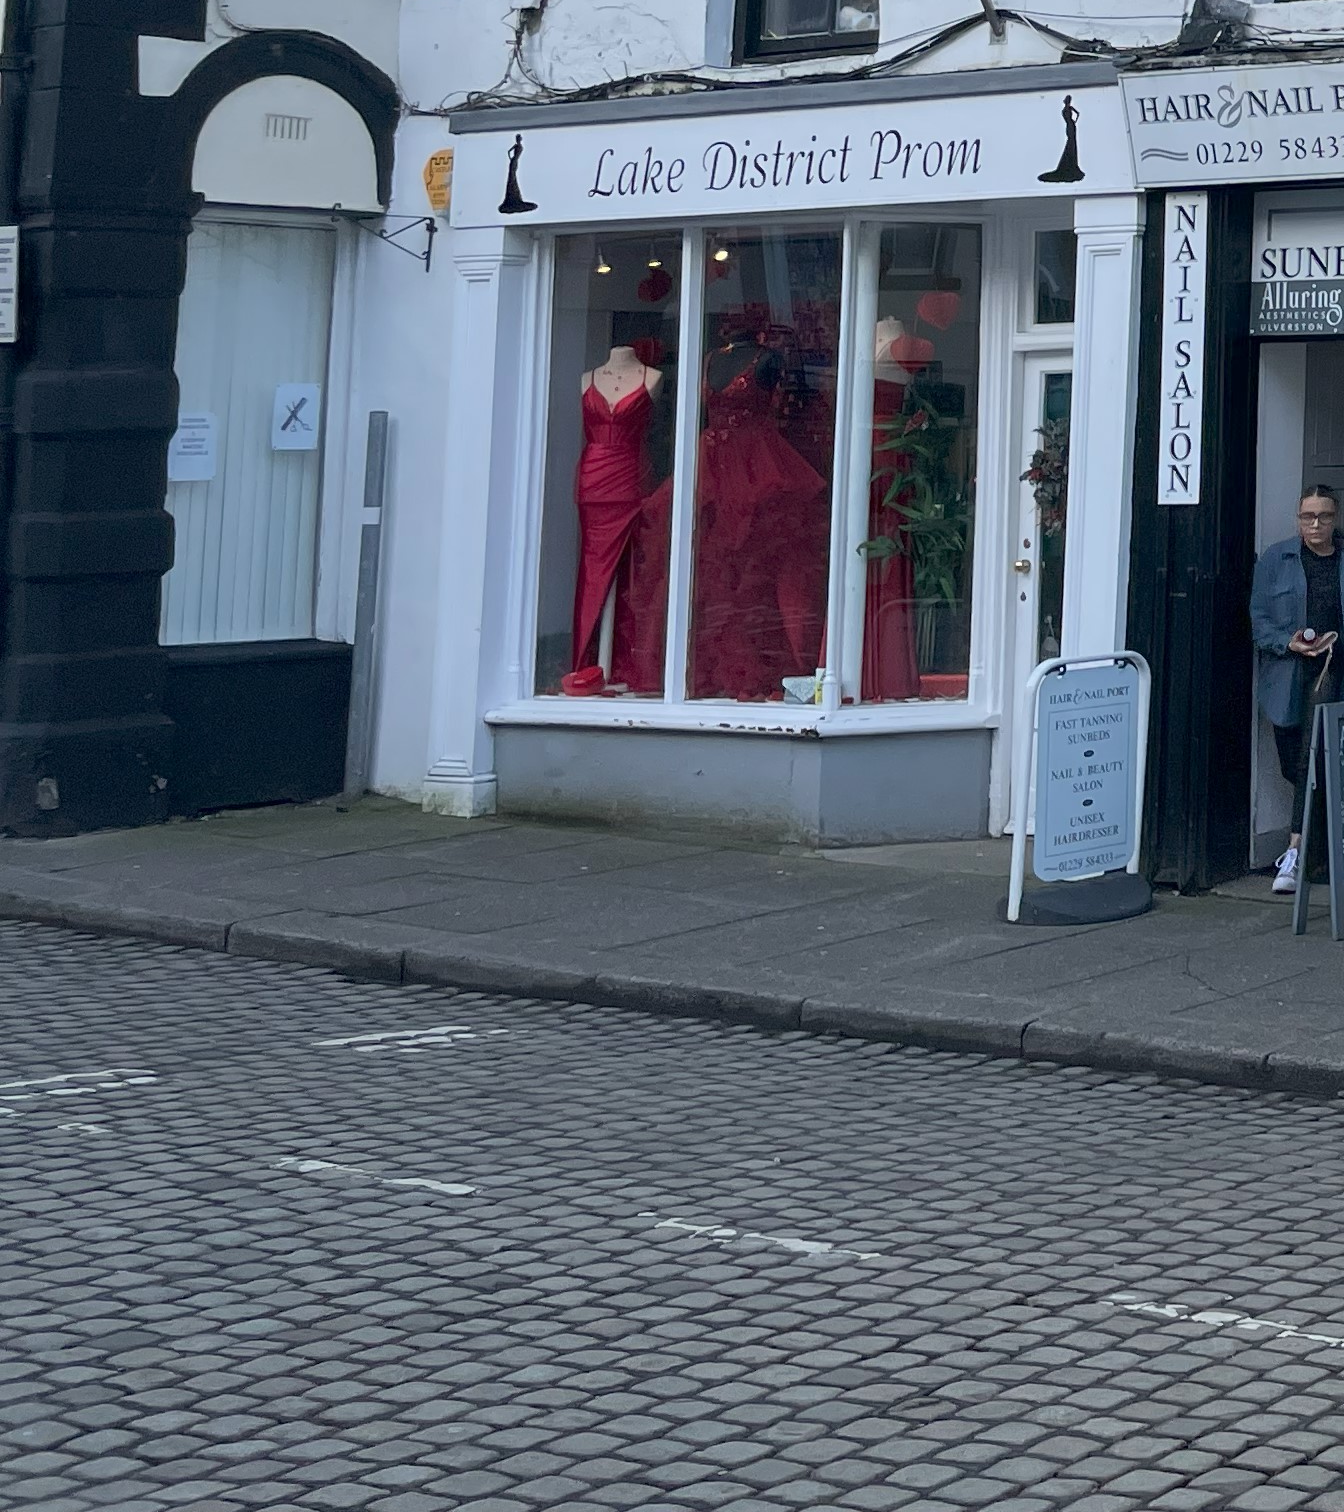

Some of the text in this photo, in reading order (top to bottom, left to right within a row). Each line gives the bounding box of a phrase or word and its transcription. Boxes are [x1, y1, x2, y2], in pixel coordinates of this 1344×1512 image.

[1135, 93, 1216, 125] HAIR
[1245, 86, 1324, 118] NAIL
[1196, 140, 1263, 166] 01229
[587, 130, 982, 199] Lake District Prom
[1261, 282, 1342, 325] Alluring
[1259, 311, 1326, 320] AESTHETICS
[1260, 323, 1323, 332] ULVERSTON
[1167, 204, 1199, 494] NAIL SALON
[1050, 693, 1073, 705] HAIR
[1084, 688, 1105, 701] NAIL
[1107, 686, 1130, 698] PORT
[1055, 712, 1123, 731] FAST TANNING
[1067, 730, 1110, 745] SUNBEDS
[1051, 767, 1074, 780] NAIL
[1088, 760, 1124, 775] BEAUTY
[1073, 779, 1103, 793] SALON
[1070, 812, 1105, 827] UNISEX
[1054, 825, 1119, 846] HAIRDRESSER
